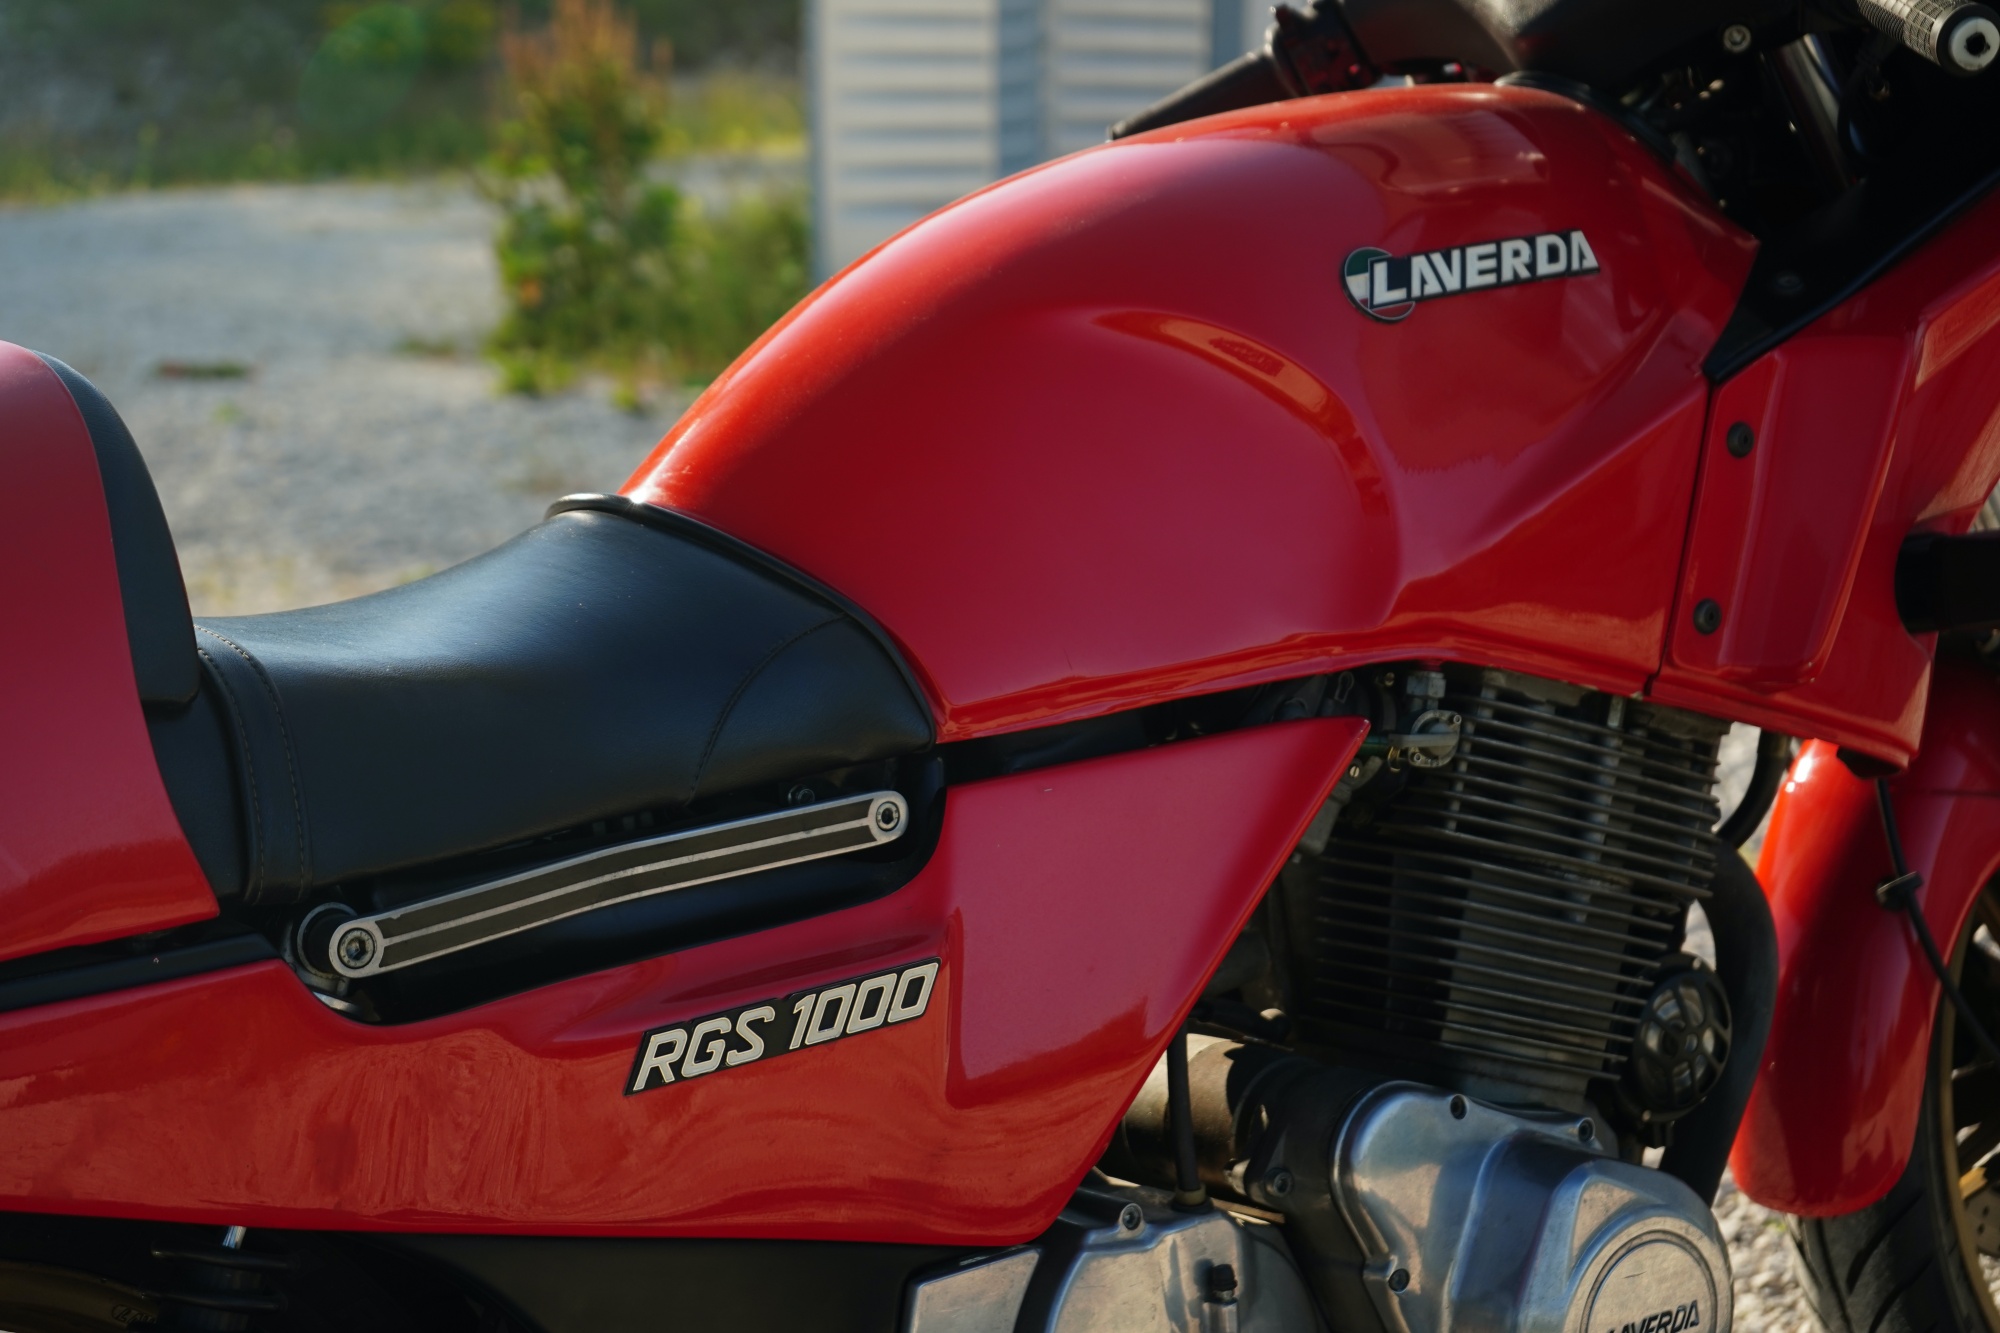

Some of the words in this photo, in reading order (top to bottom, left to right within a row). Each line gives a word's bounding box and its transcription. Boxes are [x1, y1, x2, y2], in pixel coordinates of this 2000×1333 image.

[1373, 230, 1599, 305] LAVERDA
[632, 1005, 776, 1092] RGS
[789, 962, 939, 1050] 1000
[1608, 1299, 1700, 1333] VERDA
